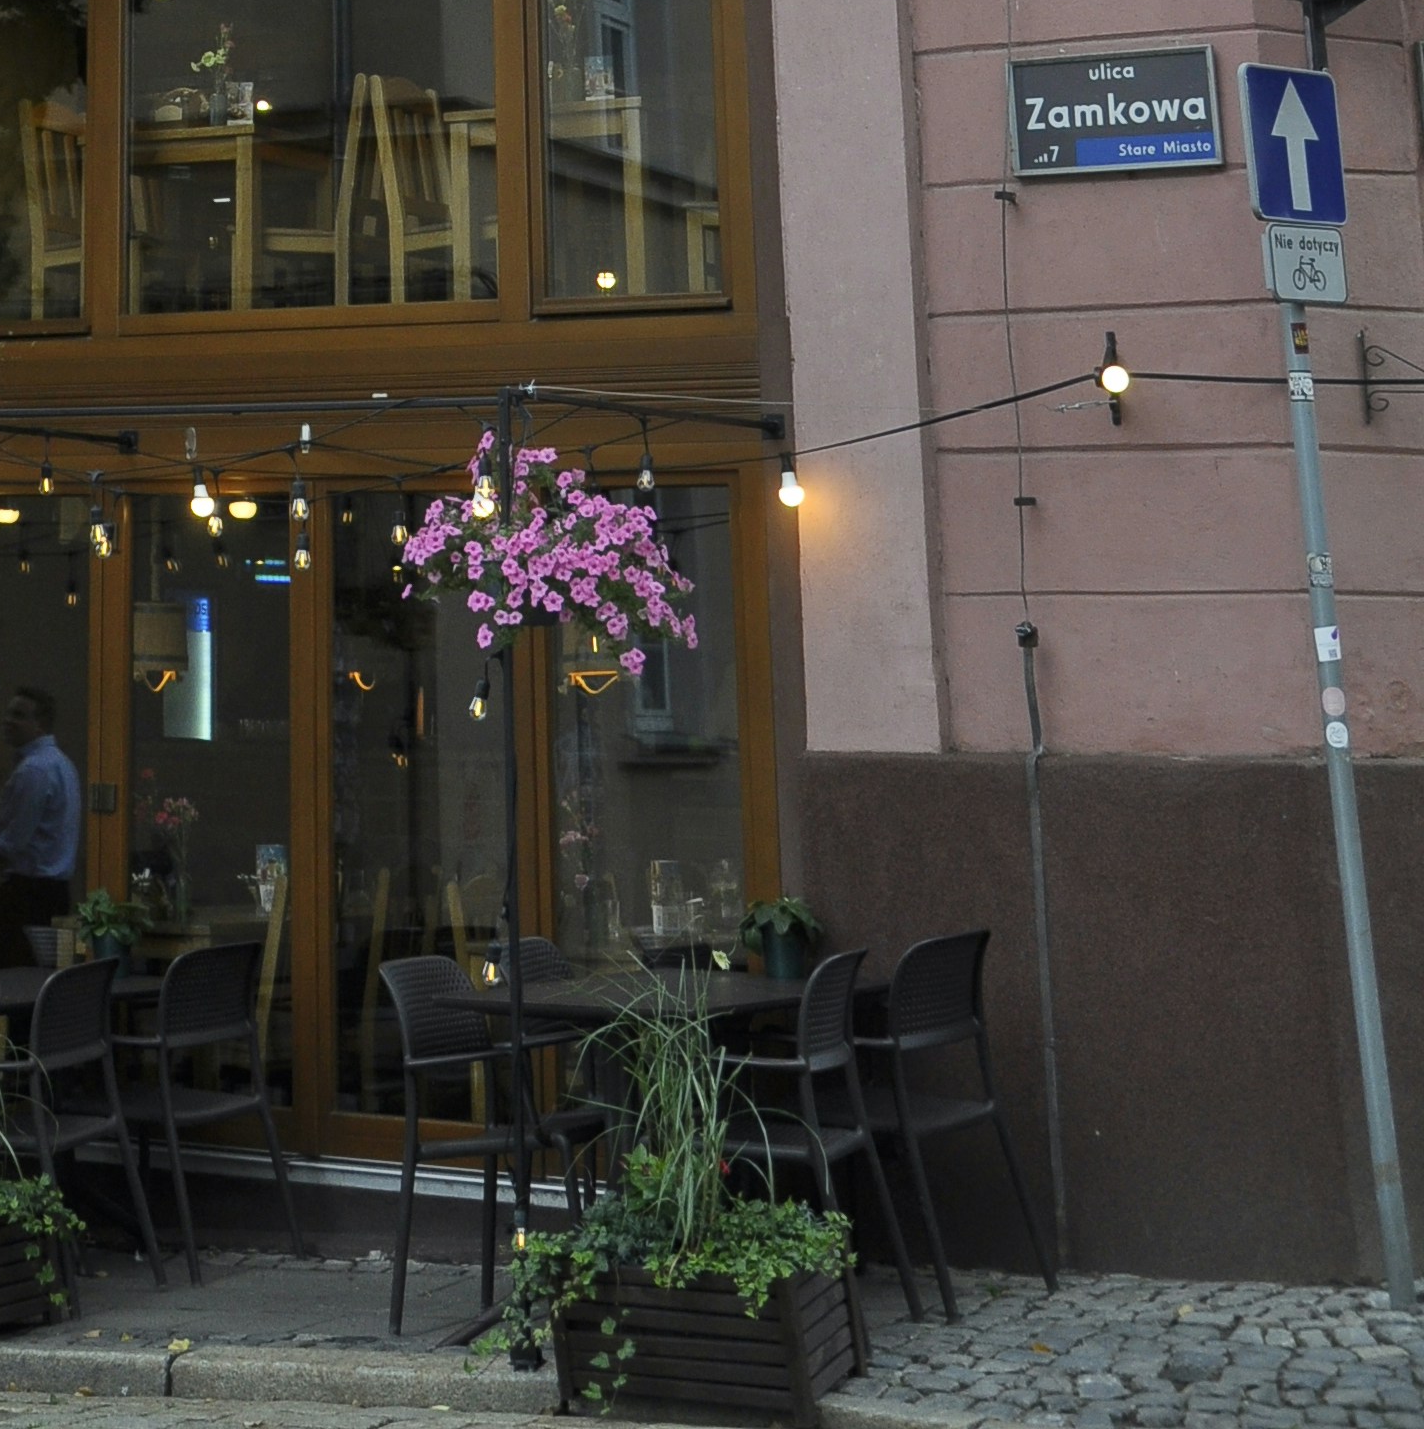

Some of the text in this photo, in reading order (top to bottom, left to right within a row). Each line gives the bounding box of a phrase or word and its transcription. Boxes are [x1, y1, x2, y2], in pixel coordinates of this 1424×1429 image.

[1088, 62, 1135, 81] ulica
[1025, 92, 1207, 131] Zamkowa
[1118, 143, 1156, 157] Stare
[1163, 141, 1212, 155] Miasto
[1274, 232, 1339, 257] Nie dotyczy
